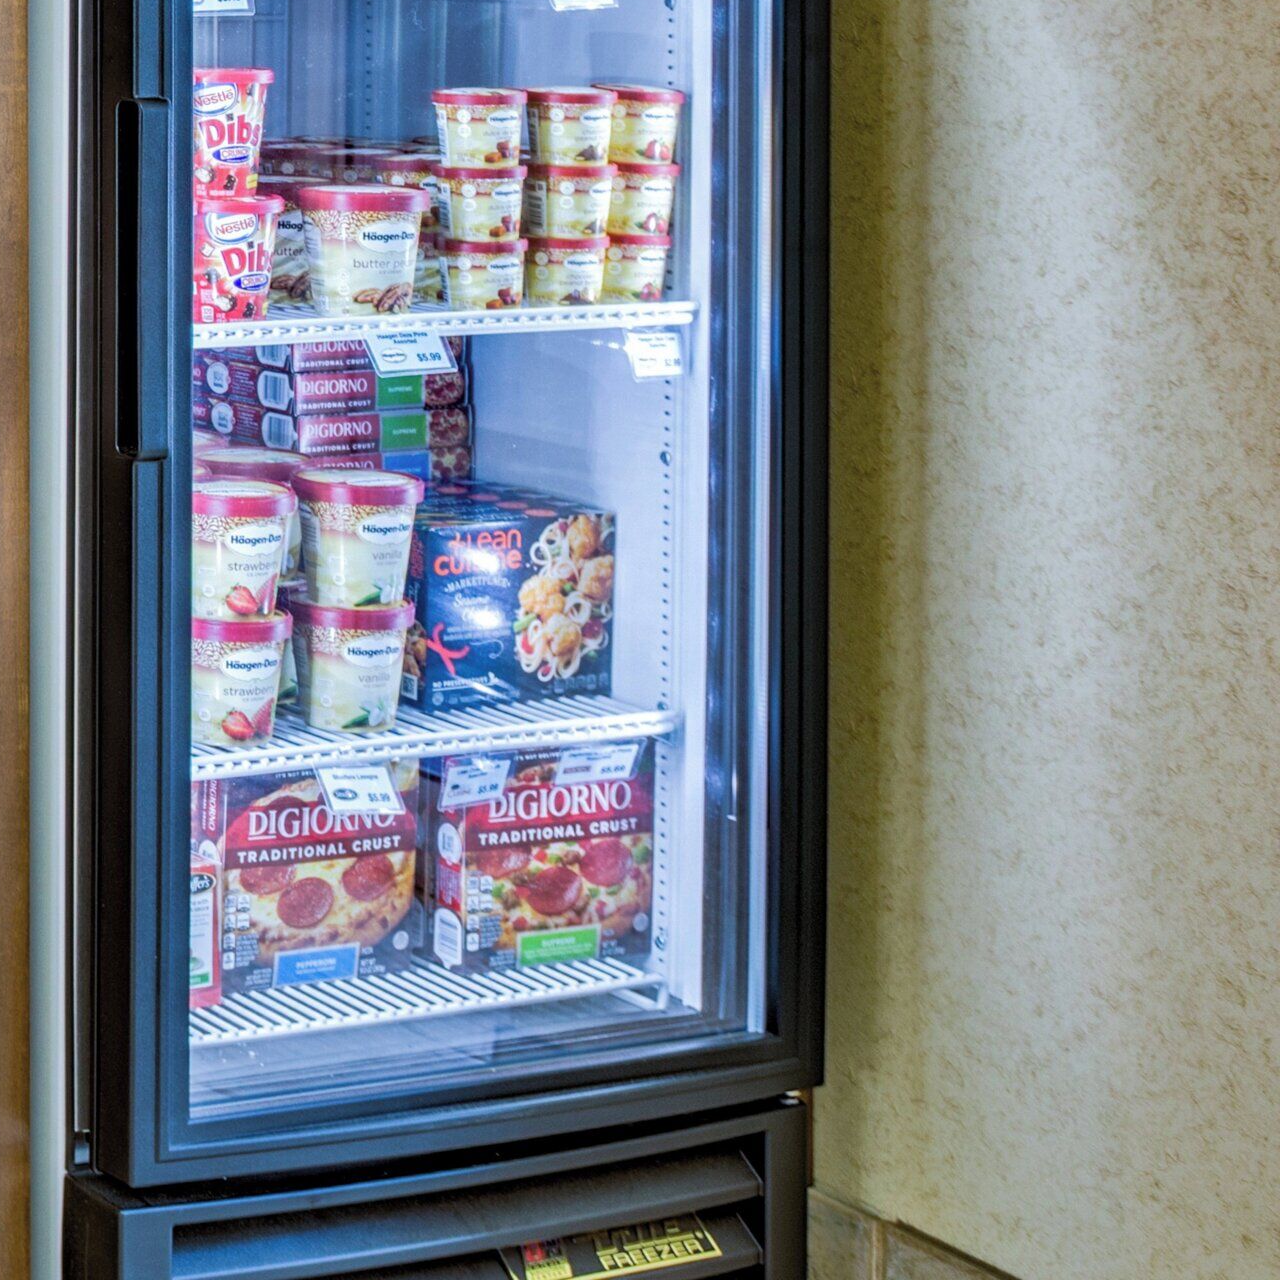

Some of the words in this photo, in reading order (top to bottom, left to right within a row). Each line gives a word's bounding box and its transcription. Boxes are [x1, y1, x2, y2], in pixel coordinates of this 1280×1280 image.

[205, 113, 262, 150] Dibs
[353, 258, 389, 269] butter
[416, 351, 441, 363] $5.99
[478, 822, 586, 847] TRADITIONAL
[588, 816, 638, 835] CRUST
[237, 838, 348, 864] TRADITIONAL
[351, 835, 402, 853] CRUST
